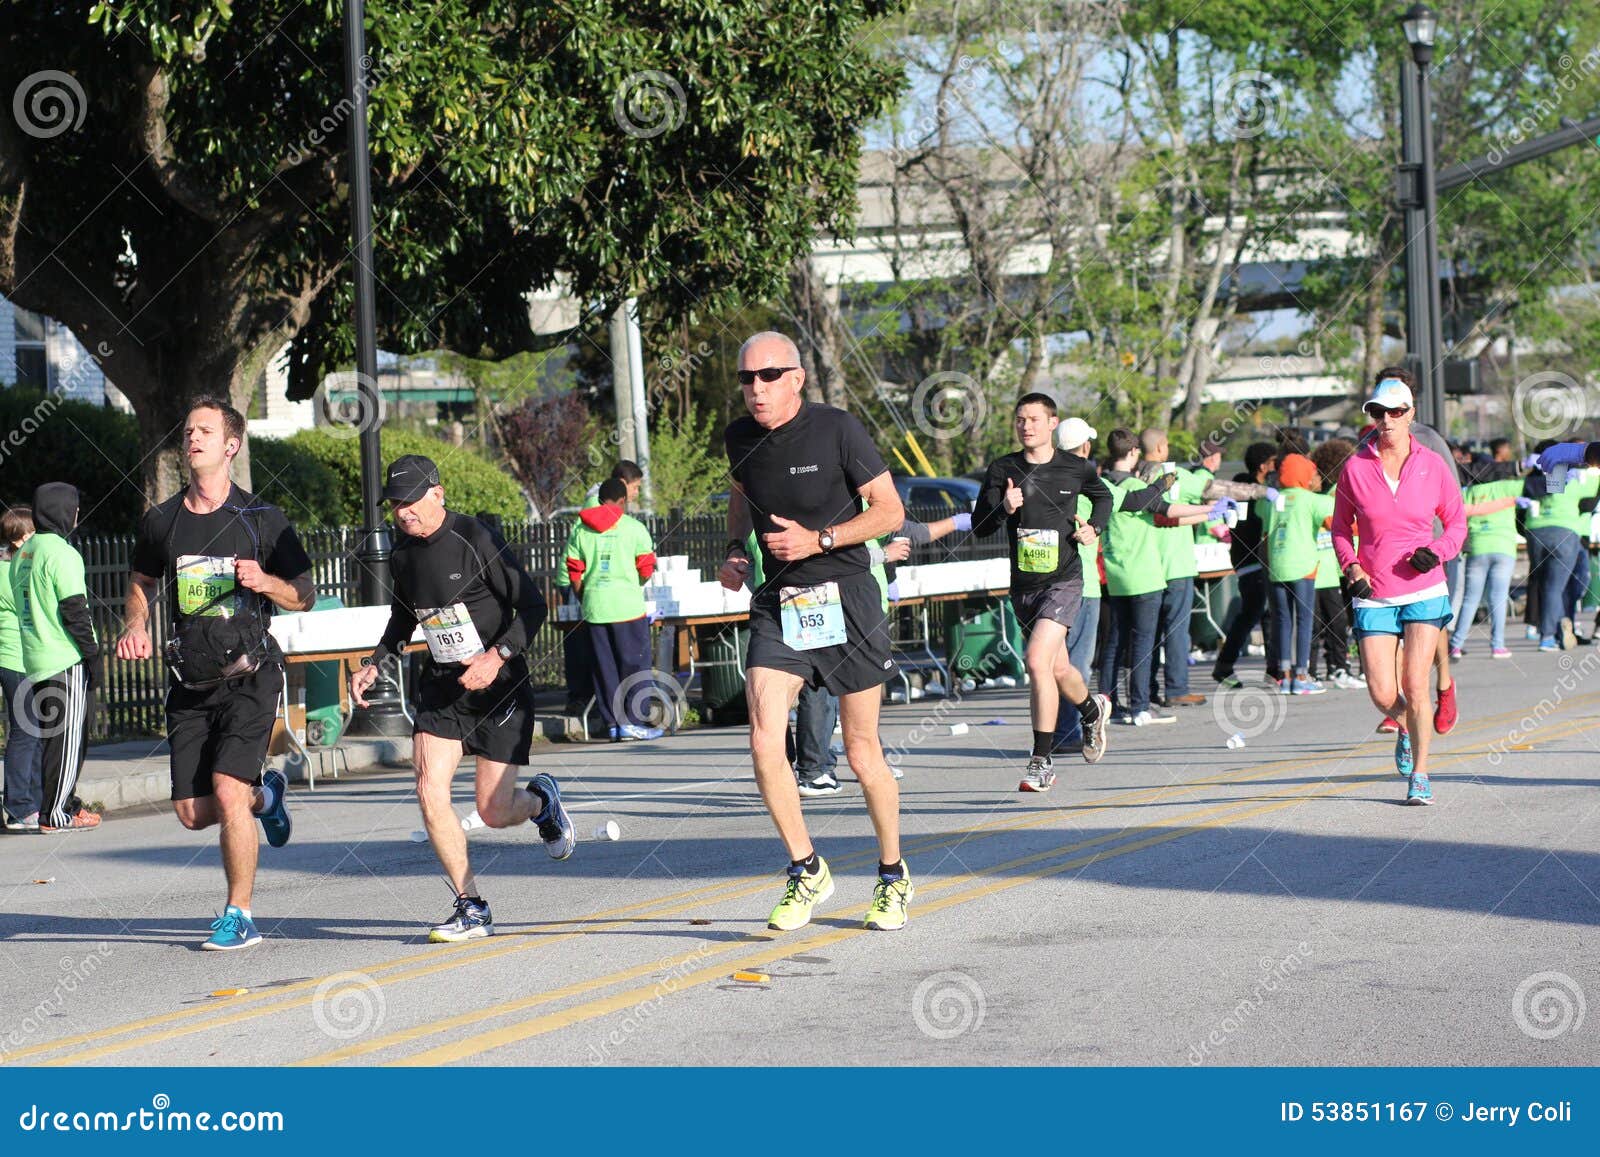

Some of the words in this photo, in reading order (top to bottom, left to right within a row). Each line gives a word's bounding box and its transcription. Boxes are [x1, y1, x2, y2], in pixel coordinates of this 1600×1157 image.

[1023, 548, 1050, 559] A4981
[187, 584, 222, 597] A6181
[799, 613, 825, 629] 653
[436, 631, 464, 646] 1613
